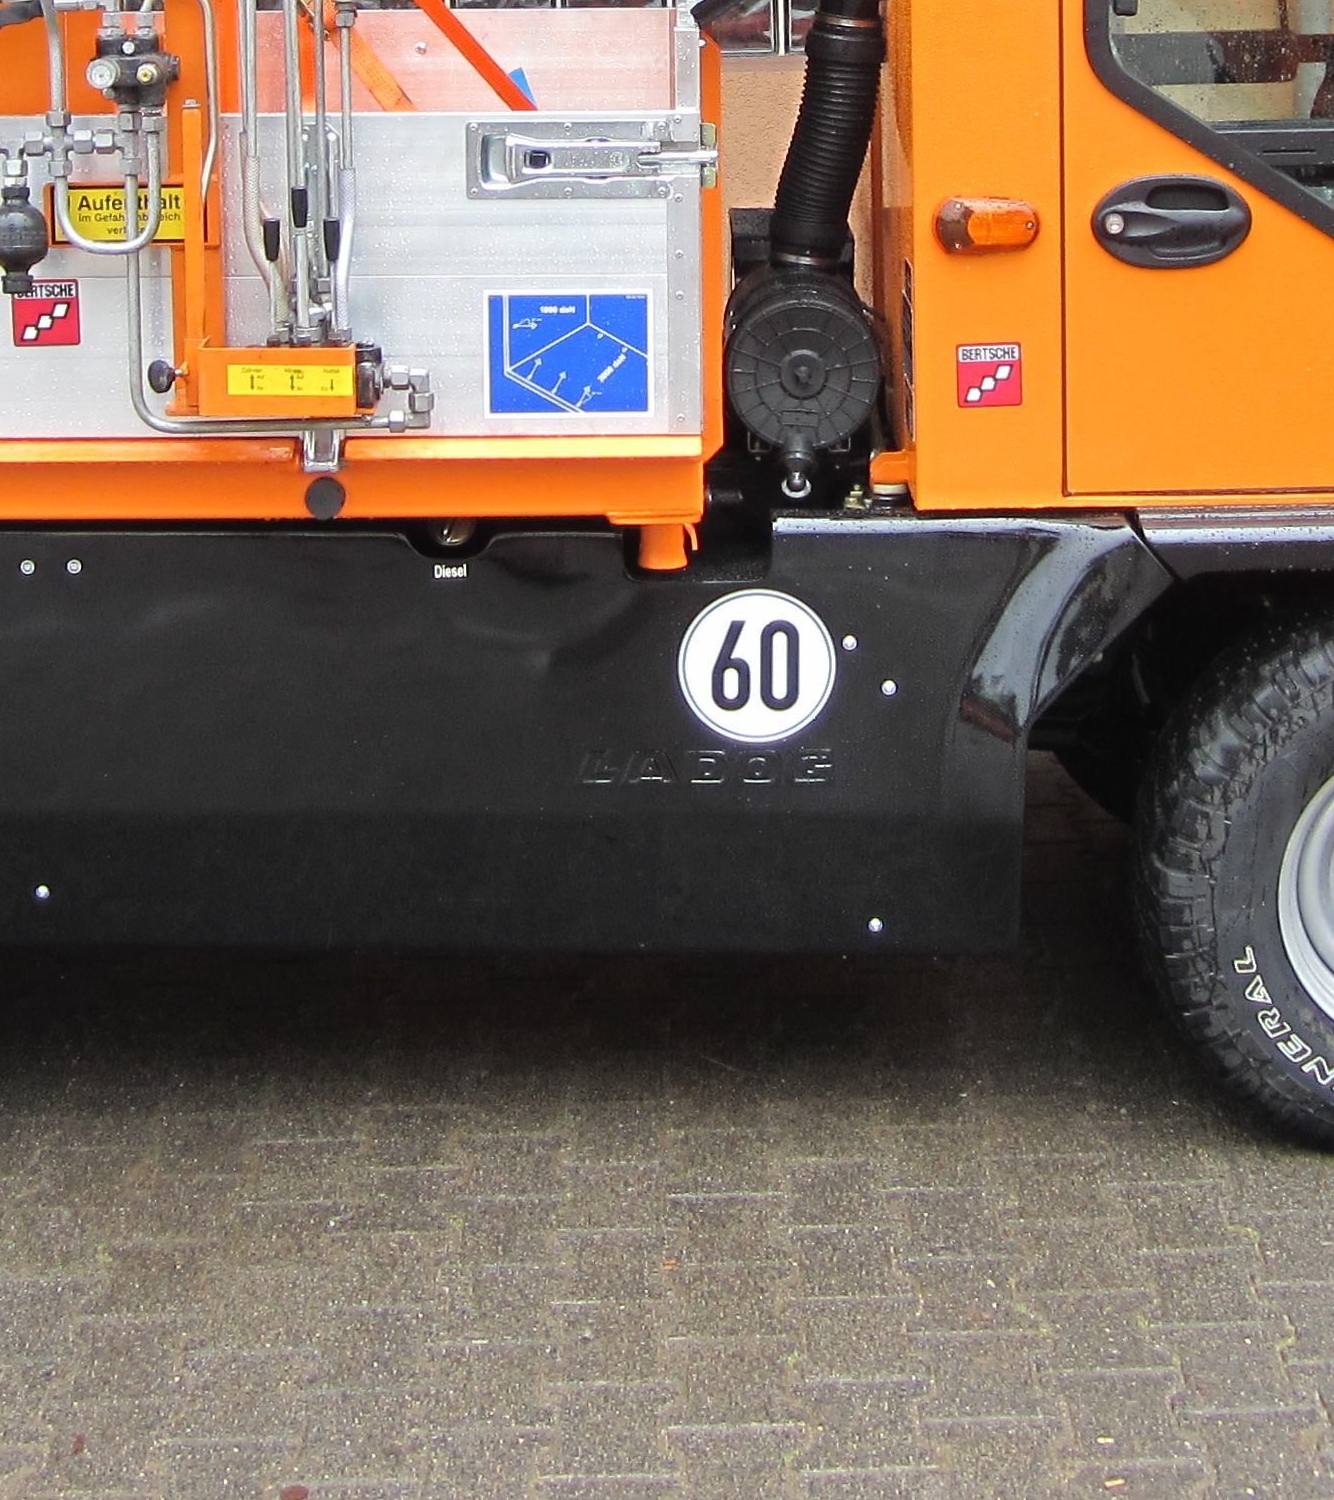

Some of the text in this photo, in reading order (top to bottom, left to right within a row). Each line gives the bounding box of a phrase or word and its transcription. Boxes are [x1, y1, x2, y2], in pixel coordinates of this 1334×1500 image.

[17, 284, 74, 298] RTSCHE
[961, 346, 1017, 361] BERTSCHE
[434, 563, 468, 579] Diesel
[711, 619, 800, 711] 60
